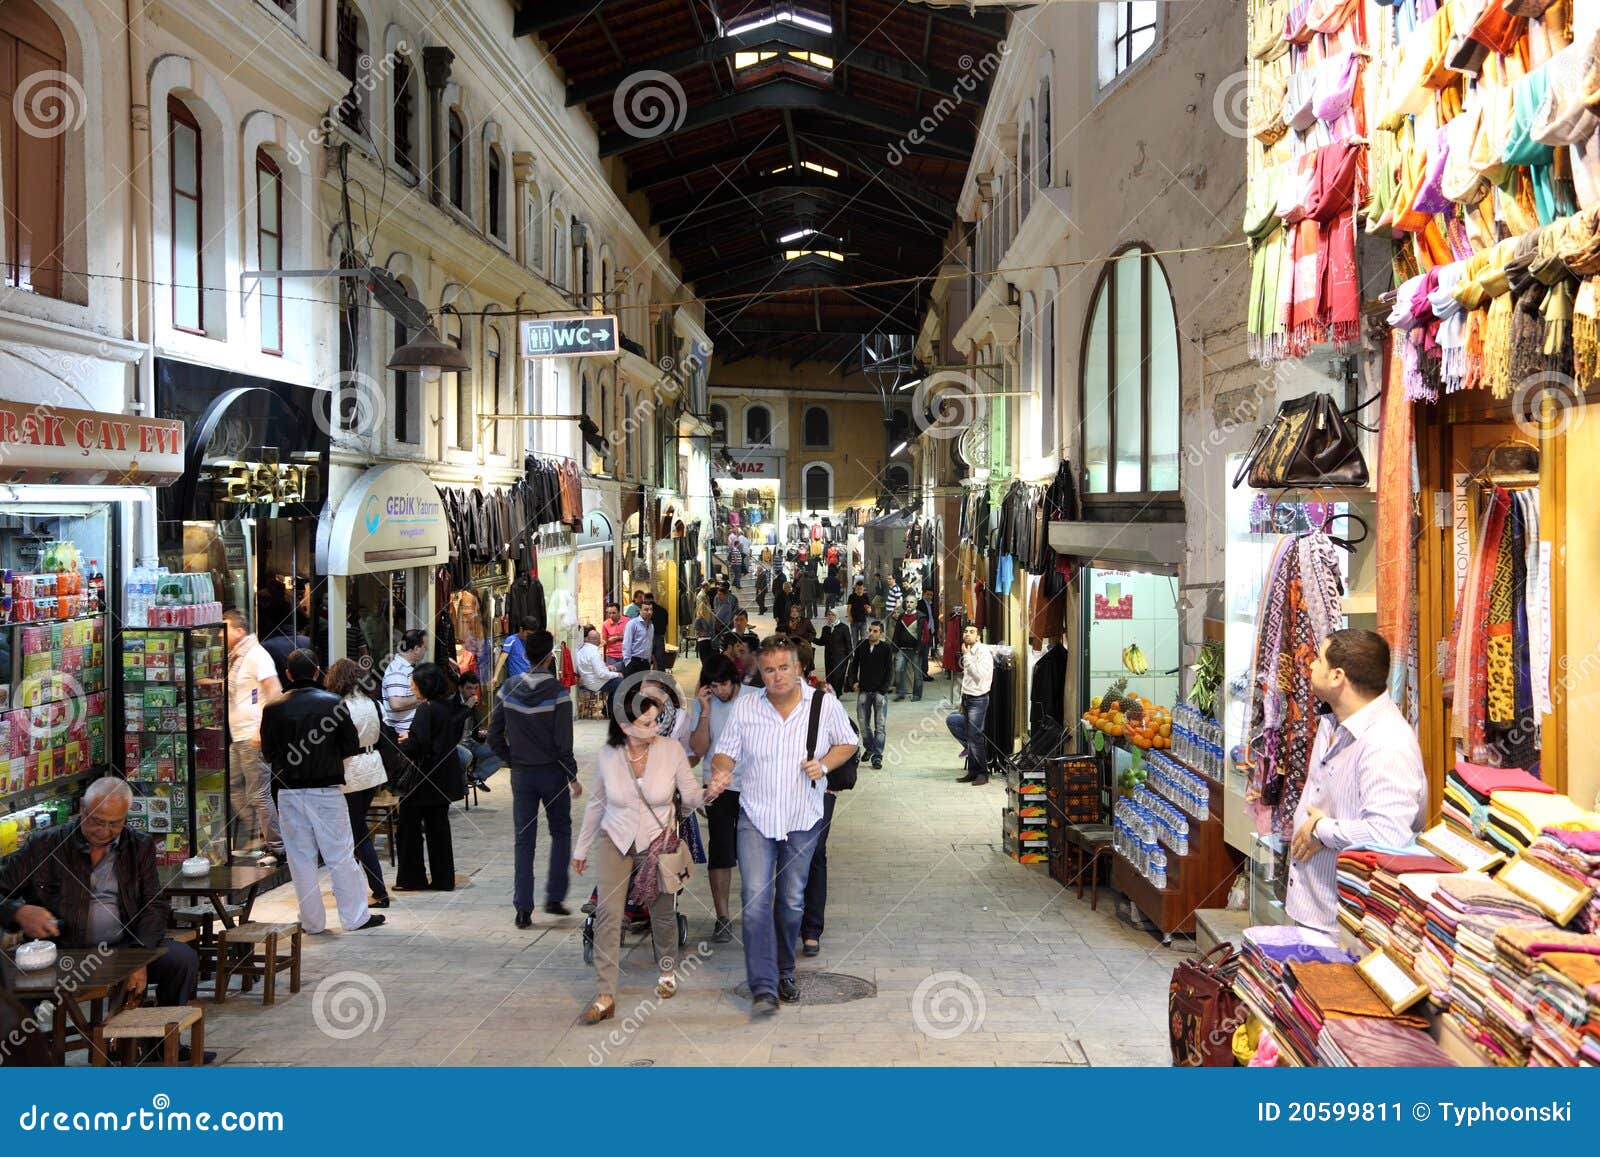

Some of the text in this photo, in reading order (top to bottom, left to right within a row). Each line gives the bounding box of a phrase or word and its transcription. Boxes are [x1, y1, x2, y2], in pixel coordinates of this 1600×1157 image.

[554, 327, 591, 346] WC
[75, 418, 130, 456] ÇAY
[138, 423, 179, 455] EVİ
[386, 493, 415, 515] GEDİK
[1455, 478, 1469, 511] SILK
